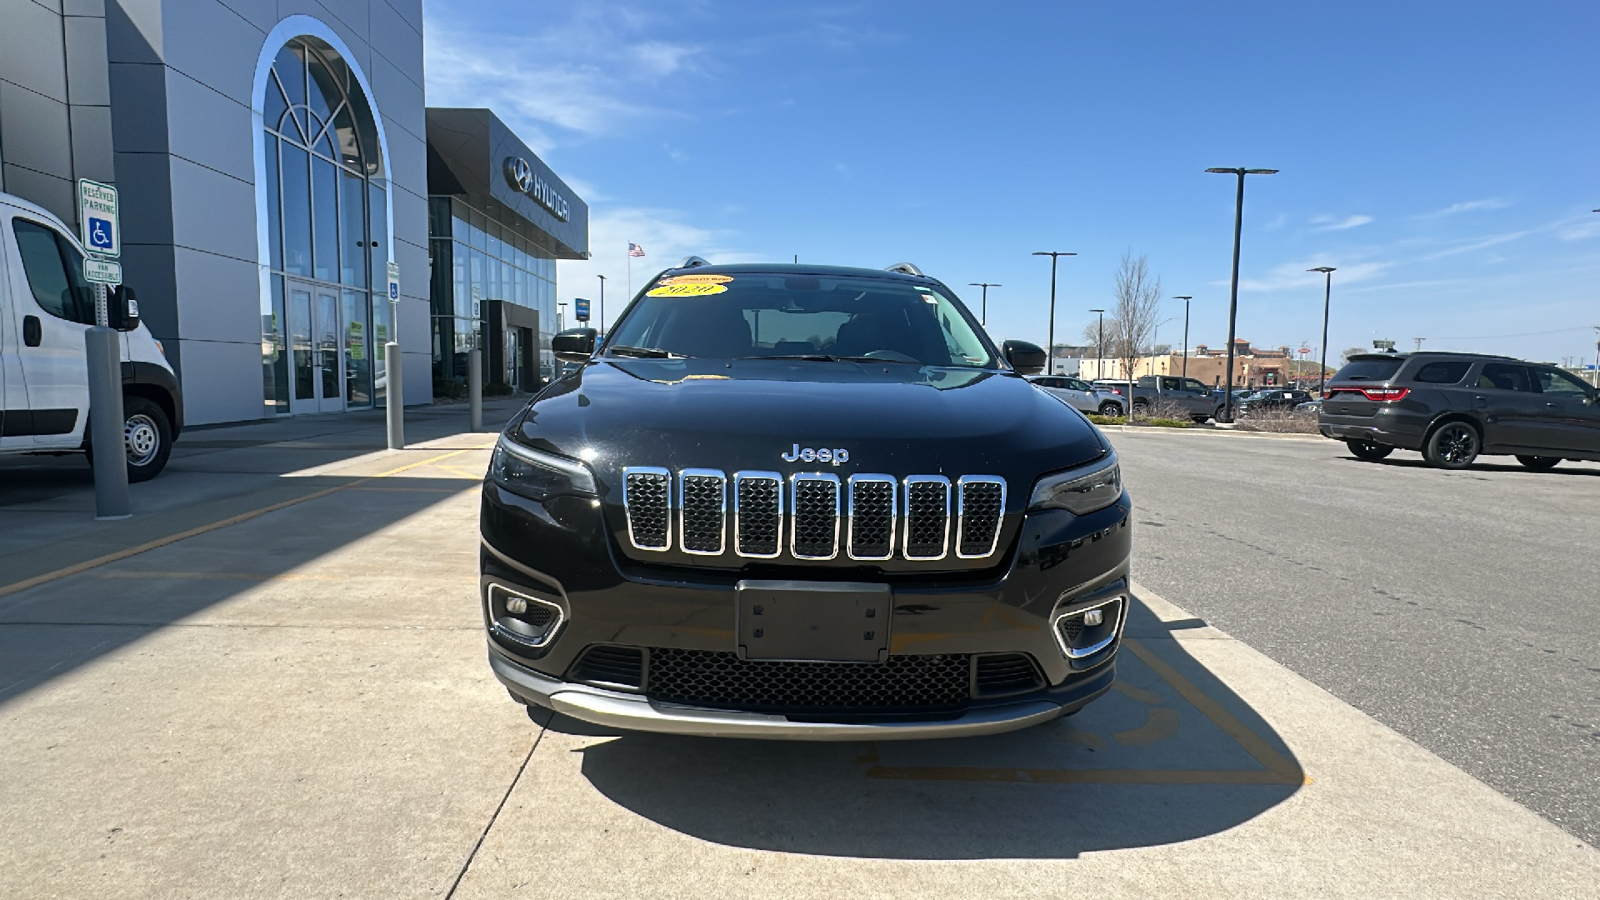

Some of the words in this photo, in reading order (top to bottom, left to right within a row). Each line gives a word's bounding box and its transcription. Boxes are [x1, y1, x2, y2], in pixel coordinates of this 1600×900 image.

[83, 186, 114, 202] RESERVED
[534, 173, 570, 222] HYUNDAI
[84, 198, 115, 214] PARKING
[781, 443, 849, 466] Jeep
